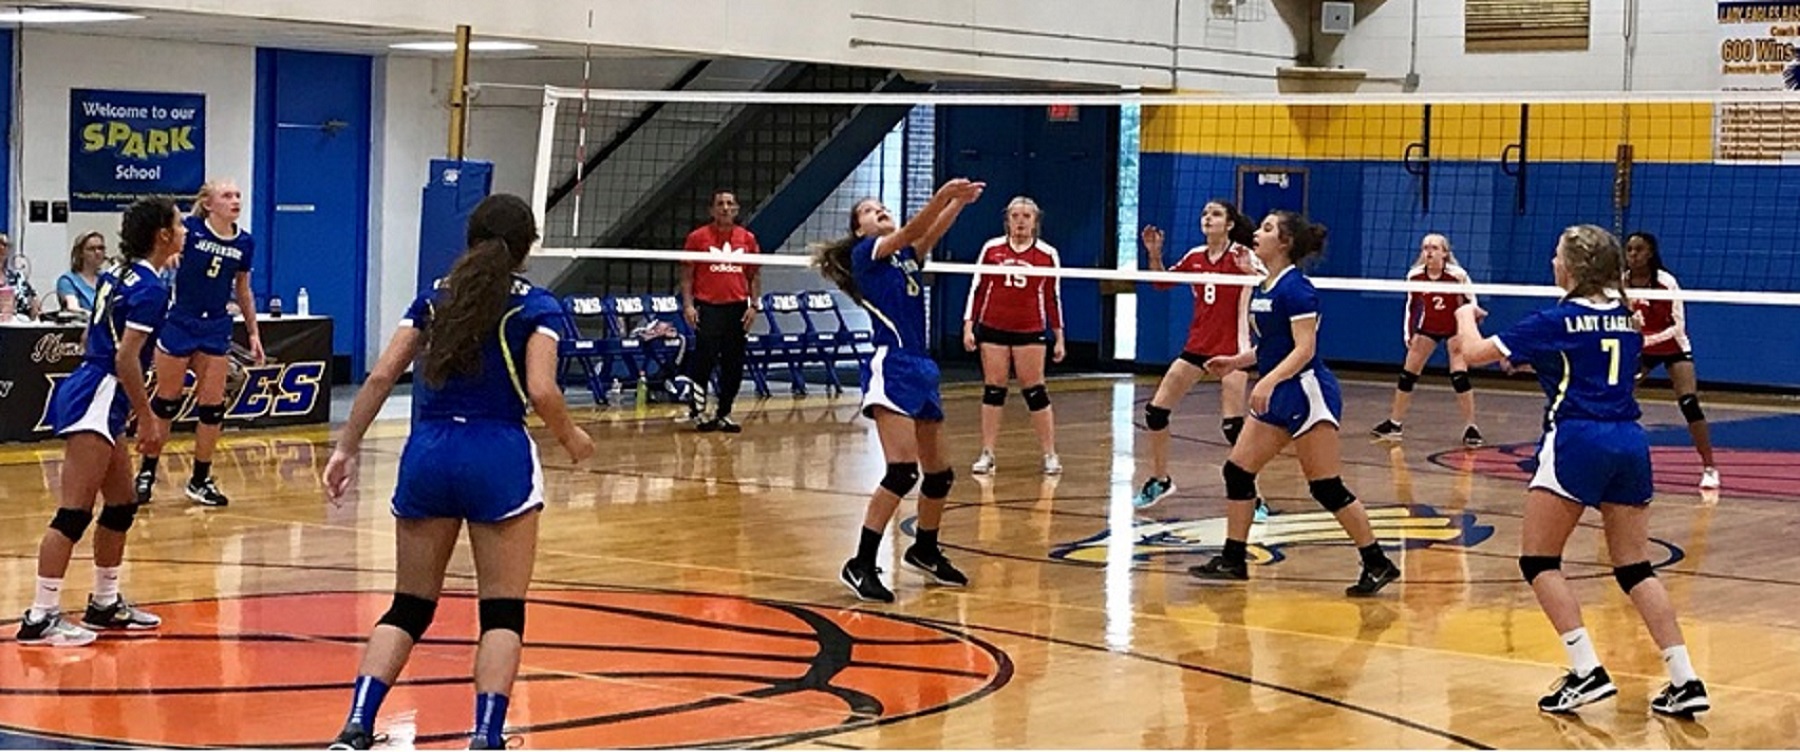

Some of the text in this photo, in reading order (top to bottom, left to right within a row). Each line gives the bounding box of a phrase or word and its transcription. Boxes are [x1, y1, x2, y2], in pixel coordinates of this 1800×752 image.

[1744, 6, 1780, 21] EAGLES
[1721, 38, 1795, 62] 600 Wins
[82, 102, 196, 120] Welcome to our
[83, 121, 195, 160] SPARK
[115, 165, 161, 180] School
[207, 255, 223, 278] 5
[709, 263, 743, 273] adidas
[1204, 283, 1216, 305] 8
[1432, 296, 1447, 311] 2
[1565, 315, 1600, 333] LADY
[1600, 338, 1620, 386] 7
